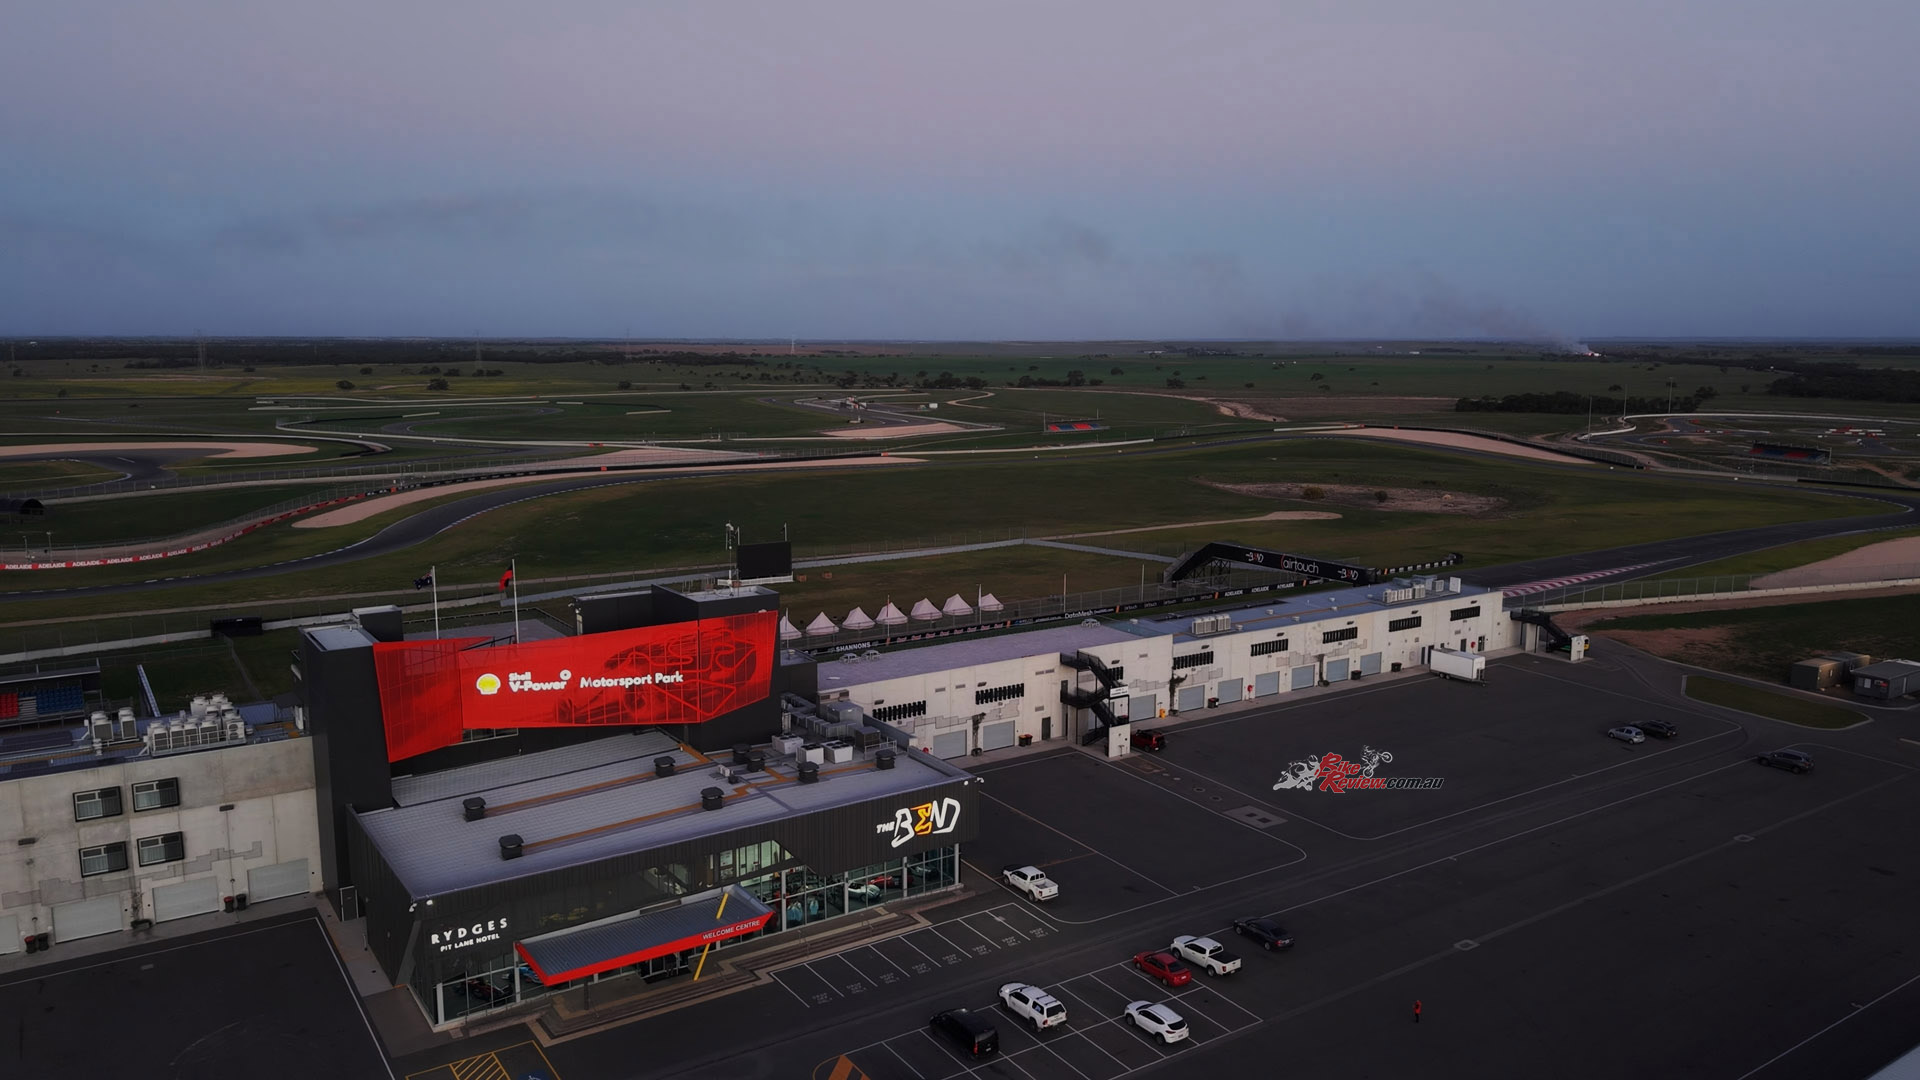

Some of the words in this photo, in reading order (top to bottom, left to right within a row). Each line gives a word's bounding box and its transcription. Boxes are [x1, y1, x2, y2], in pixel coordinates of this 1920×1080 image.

[139, 553, 163, 561] ADELAIDE
[1282, 558, 1319, 574] airtouch
[1224, 589, 1243, 597] ADELAIDE
[1277, 582, 1295, 590] ADELAIDE
[835, 641, 871, 652] SHANNONS
[508, 671, 532, 681] Shell
[579, 674, 652, 689] Motorsport
[655, 671, 684, 684] Park
[508, 679, 567, 692] V-Power
[876, 821, 896, 834] THE
[891, 797, 961, 848] BEND
[431, 917, 508, 945] RYDGES
[702, 926, 735, 940] WELCOME
[735, 920, 761, 931] CENTRE
[440, 944, 453, 952] PIT
[454, 938, 475, 949] LANE
[475, 933, 501, 944] HOTEL
